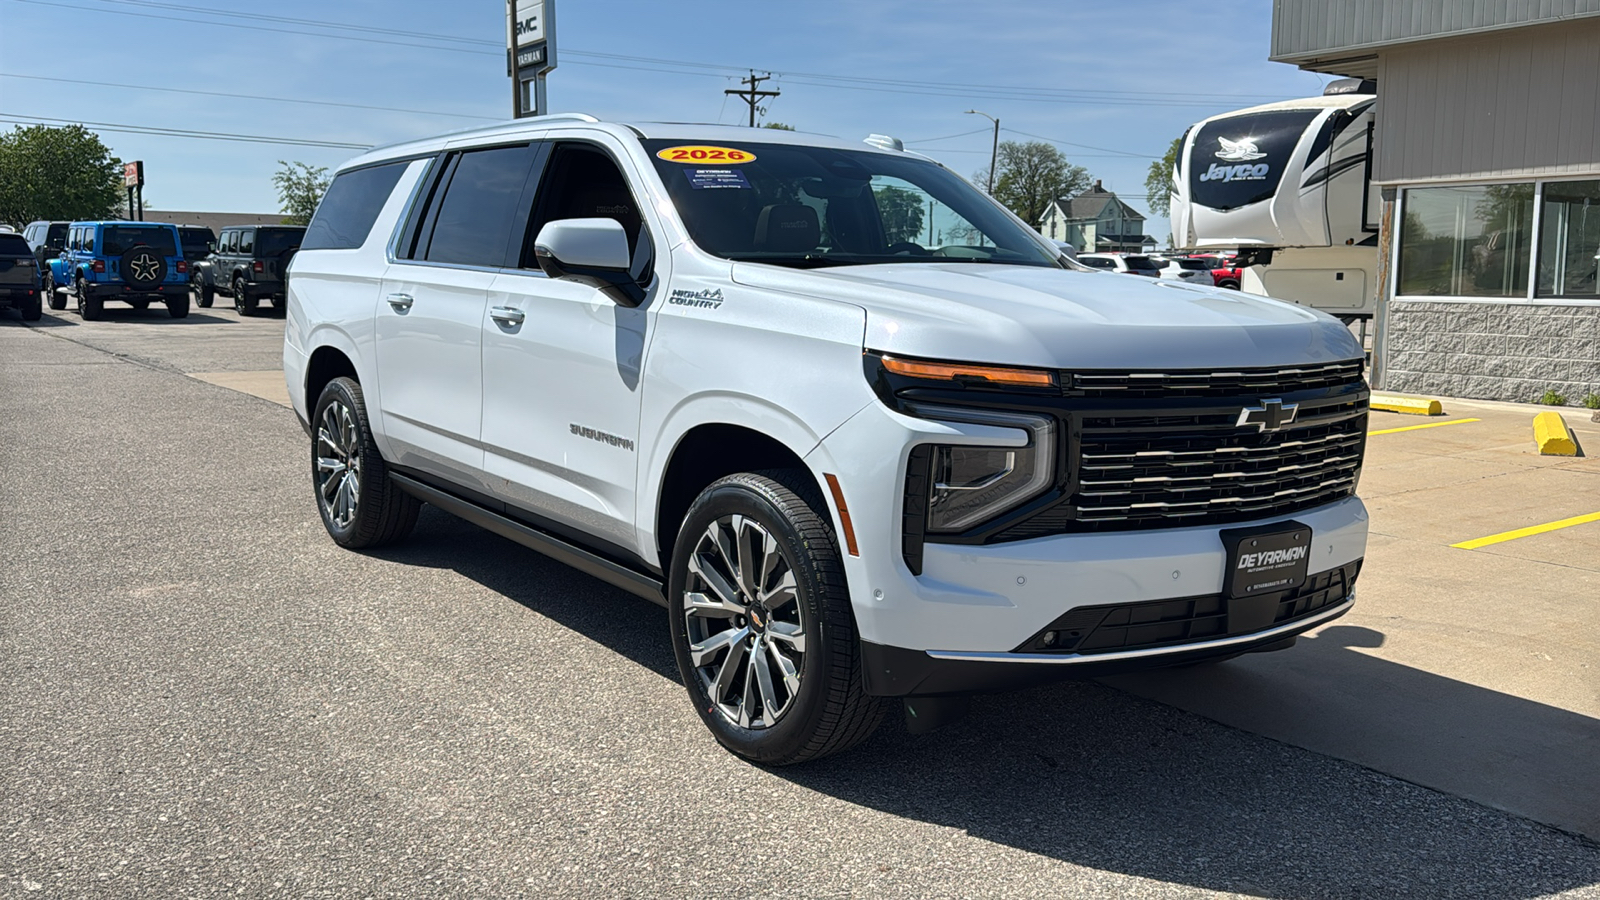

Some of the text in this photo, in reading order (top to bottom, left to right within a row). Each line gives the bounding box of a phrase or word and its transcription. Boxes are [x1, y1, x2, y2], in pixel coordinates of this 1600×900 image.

[671, 150, 745, 160] 2026
[1200, 163, 1269, 183] Jayco
[672, 289, 698, 299] HIGH
[669, 297, 722, 309] COUNTRY
[569, 423, 635, 452] SUBURBAN
[1237, 545, 1308, 570] DEYARMAN
